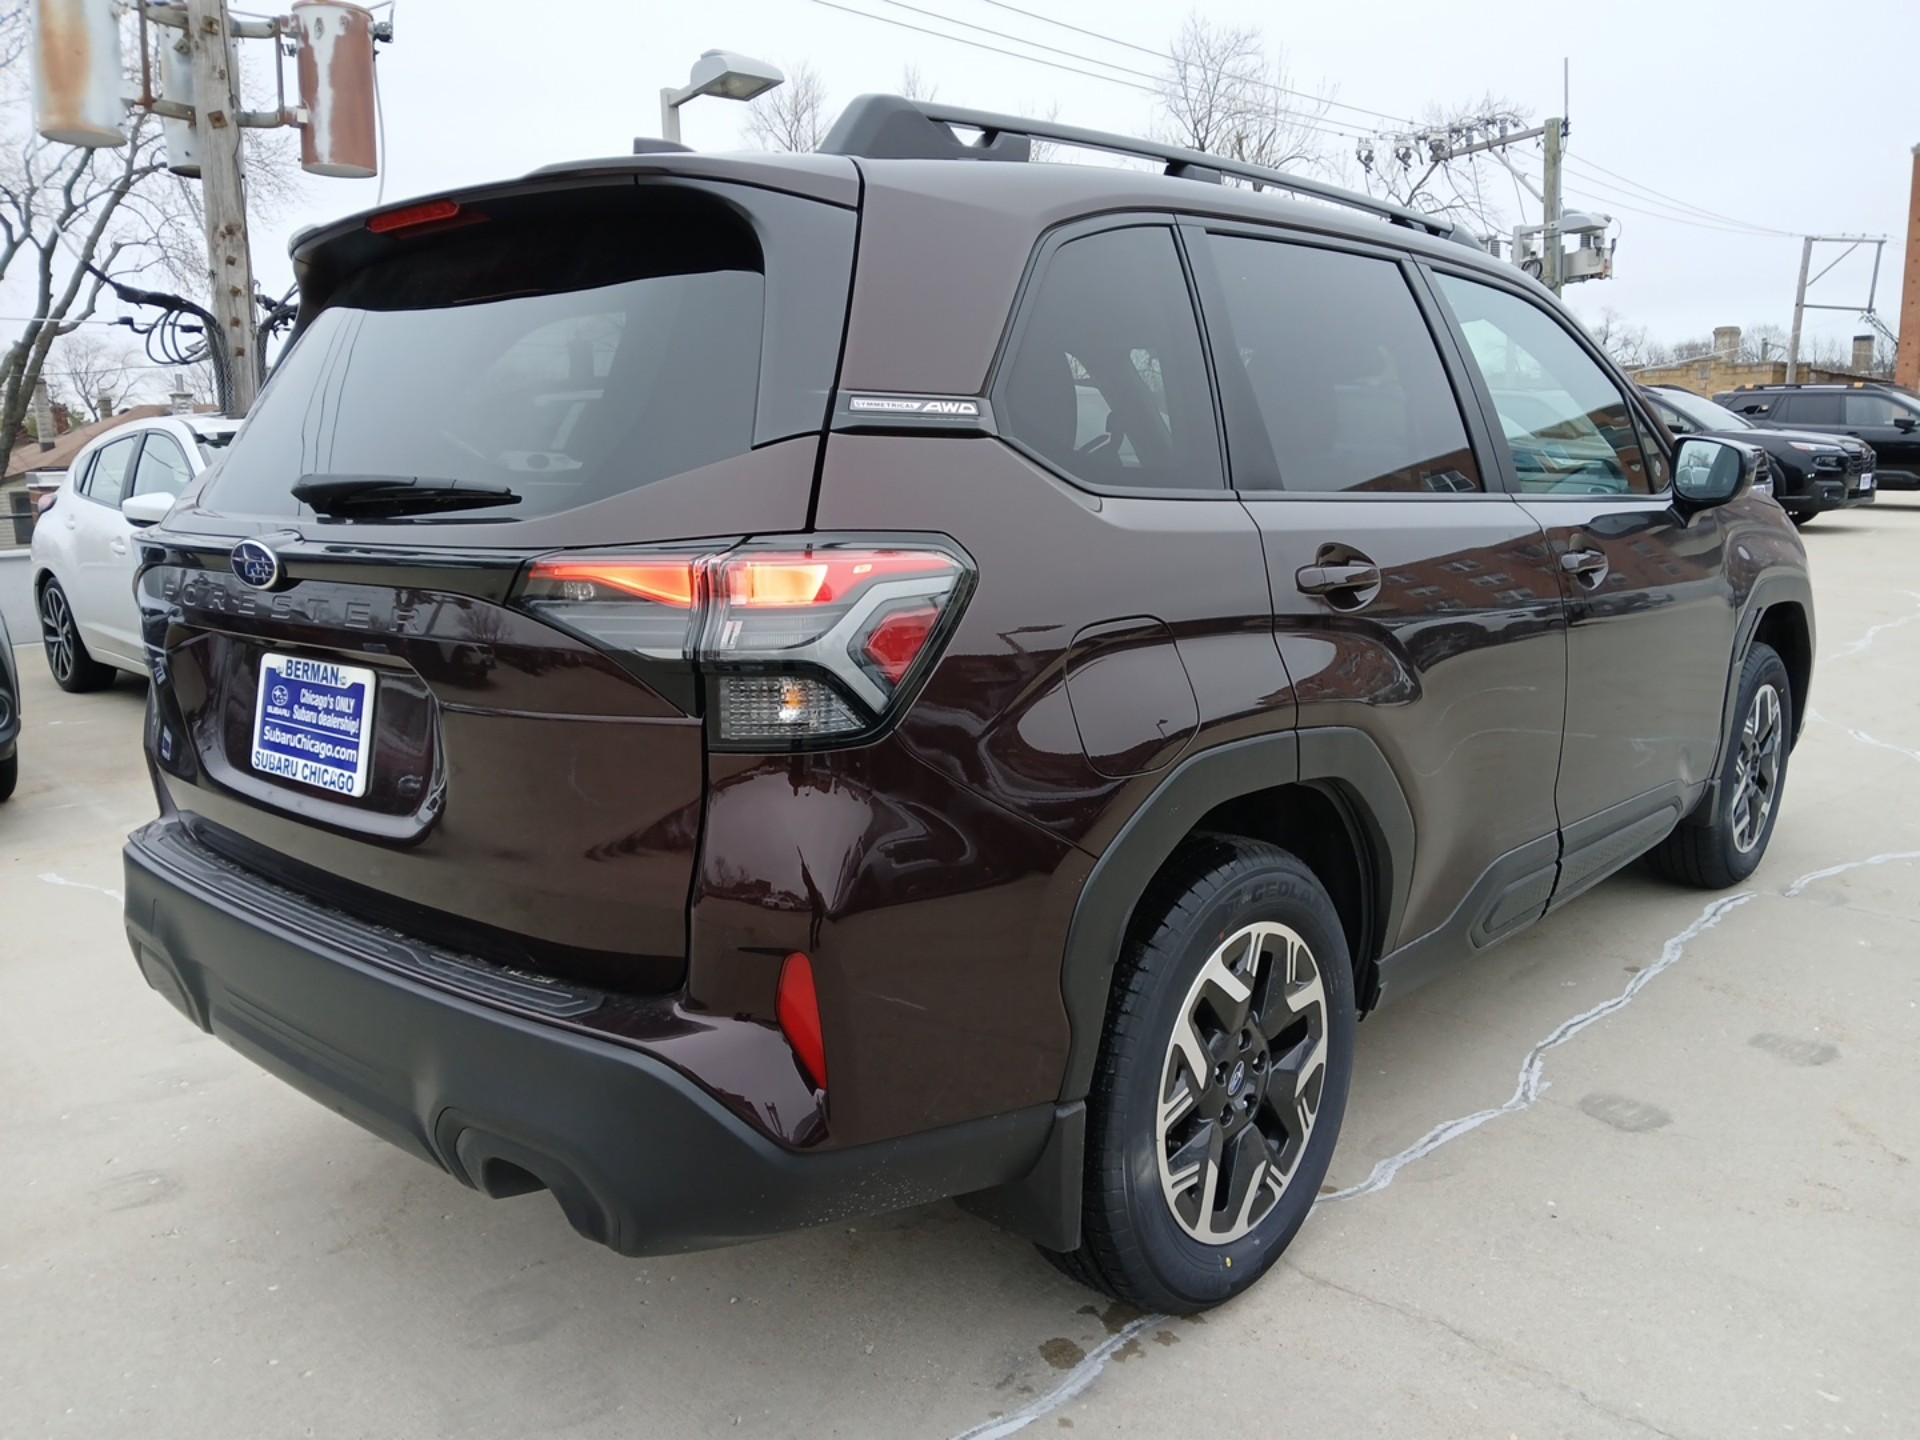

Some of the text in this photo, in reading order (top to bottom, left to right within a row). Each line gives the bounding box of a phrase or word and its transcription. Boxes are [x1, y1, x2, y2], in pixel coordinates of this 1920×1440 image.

[921, 401, 979, 415] AWD
[286, 659, 340, 686] BERMAN
[300, 688, 356, 714] Chicago's ONLY
[292, 703, 360, 735] Subaru dealership!
[263, 726, 357, 763] SubaruChicago.com
[254, 750, 355, 793] SUBARU CHICAGO
